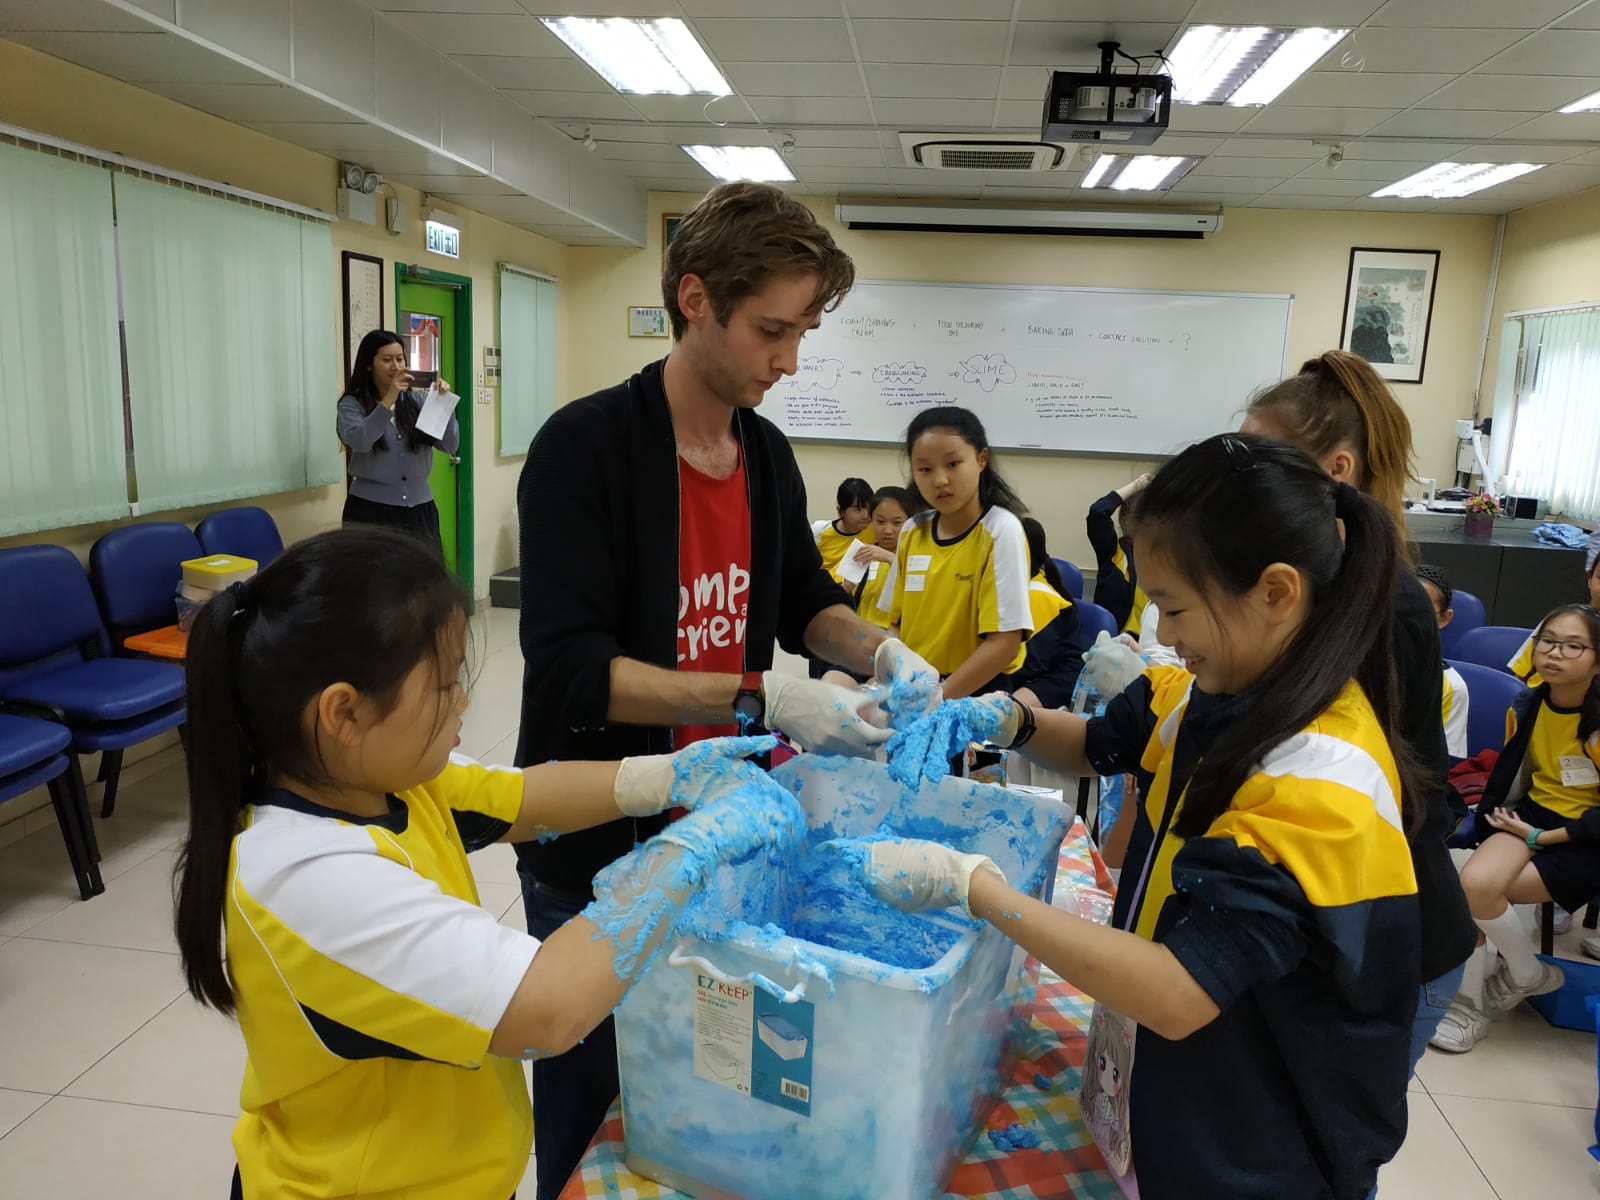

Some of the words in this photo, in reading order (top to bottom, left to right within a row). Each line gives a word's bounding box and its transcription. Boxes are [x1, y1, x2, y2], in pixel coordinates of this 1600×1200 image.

[428, 225, 444, 252] EXIT
[445, 231, 457, 256] 出口
[938, 319, 953, 329] FOOD
[1027, 325, 1053, 335] BAKING
[1098, 332, 1128, 342] CONTACT
[970, 365, 1006, 375] SLIME
[1563, 758, 1571, 767] 2
[1564, 771, 1571, 781] 3
[698, 974, 714, 991] EZ
[718, 982, 750, 1001] KEEP
